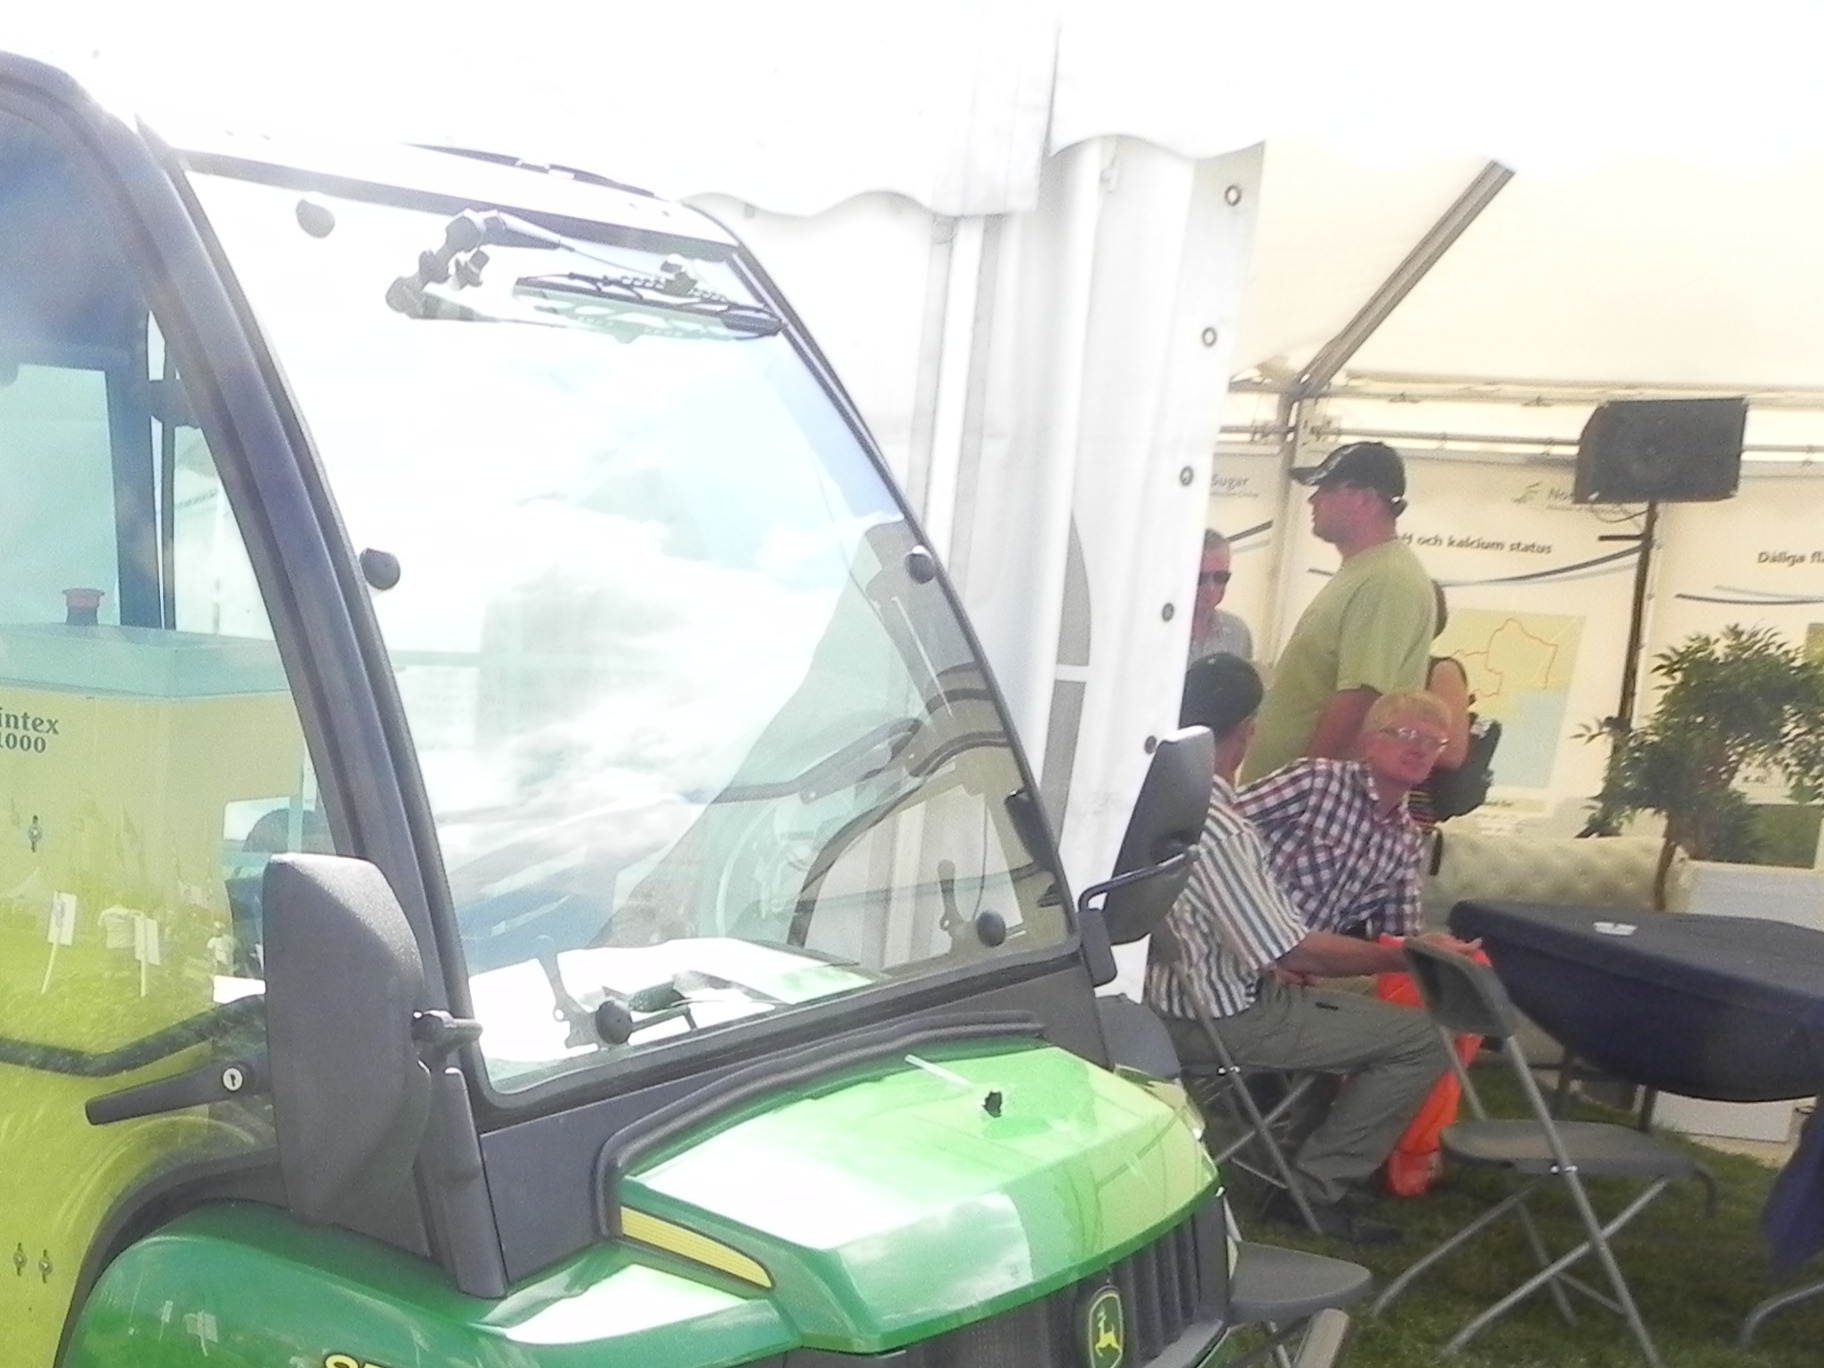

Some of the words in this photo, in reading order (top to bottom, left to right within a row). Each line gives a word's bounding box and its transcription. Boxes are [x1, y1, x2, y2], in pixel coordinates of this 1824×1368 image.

[1416, 535, 1443, 547] och
[1447, 535, 1505, 552] kalcium
[1508, 541, 1553, 554] status
